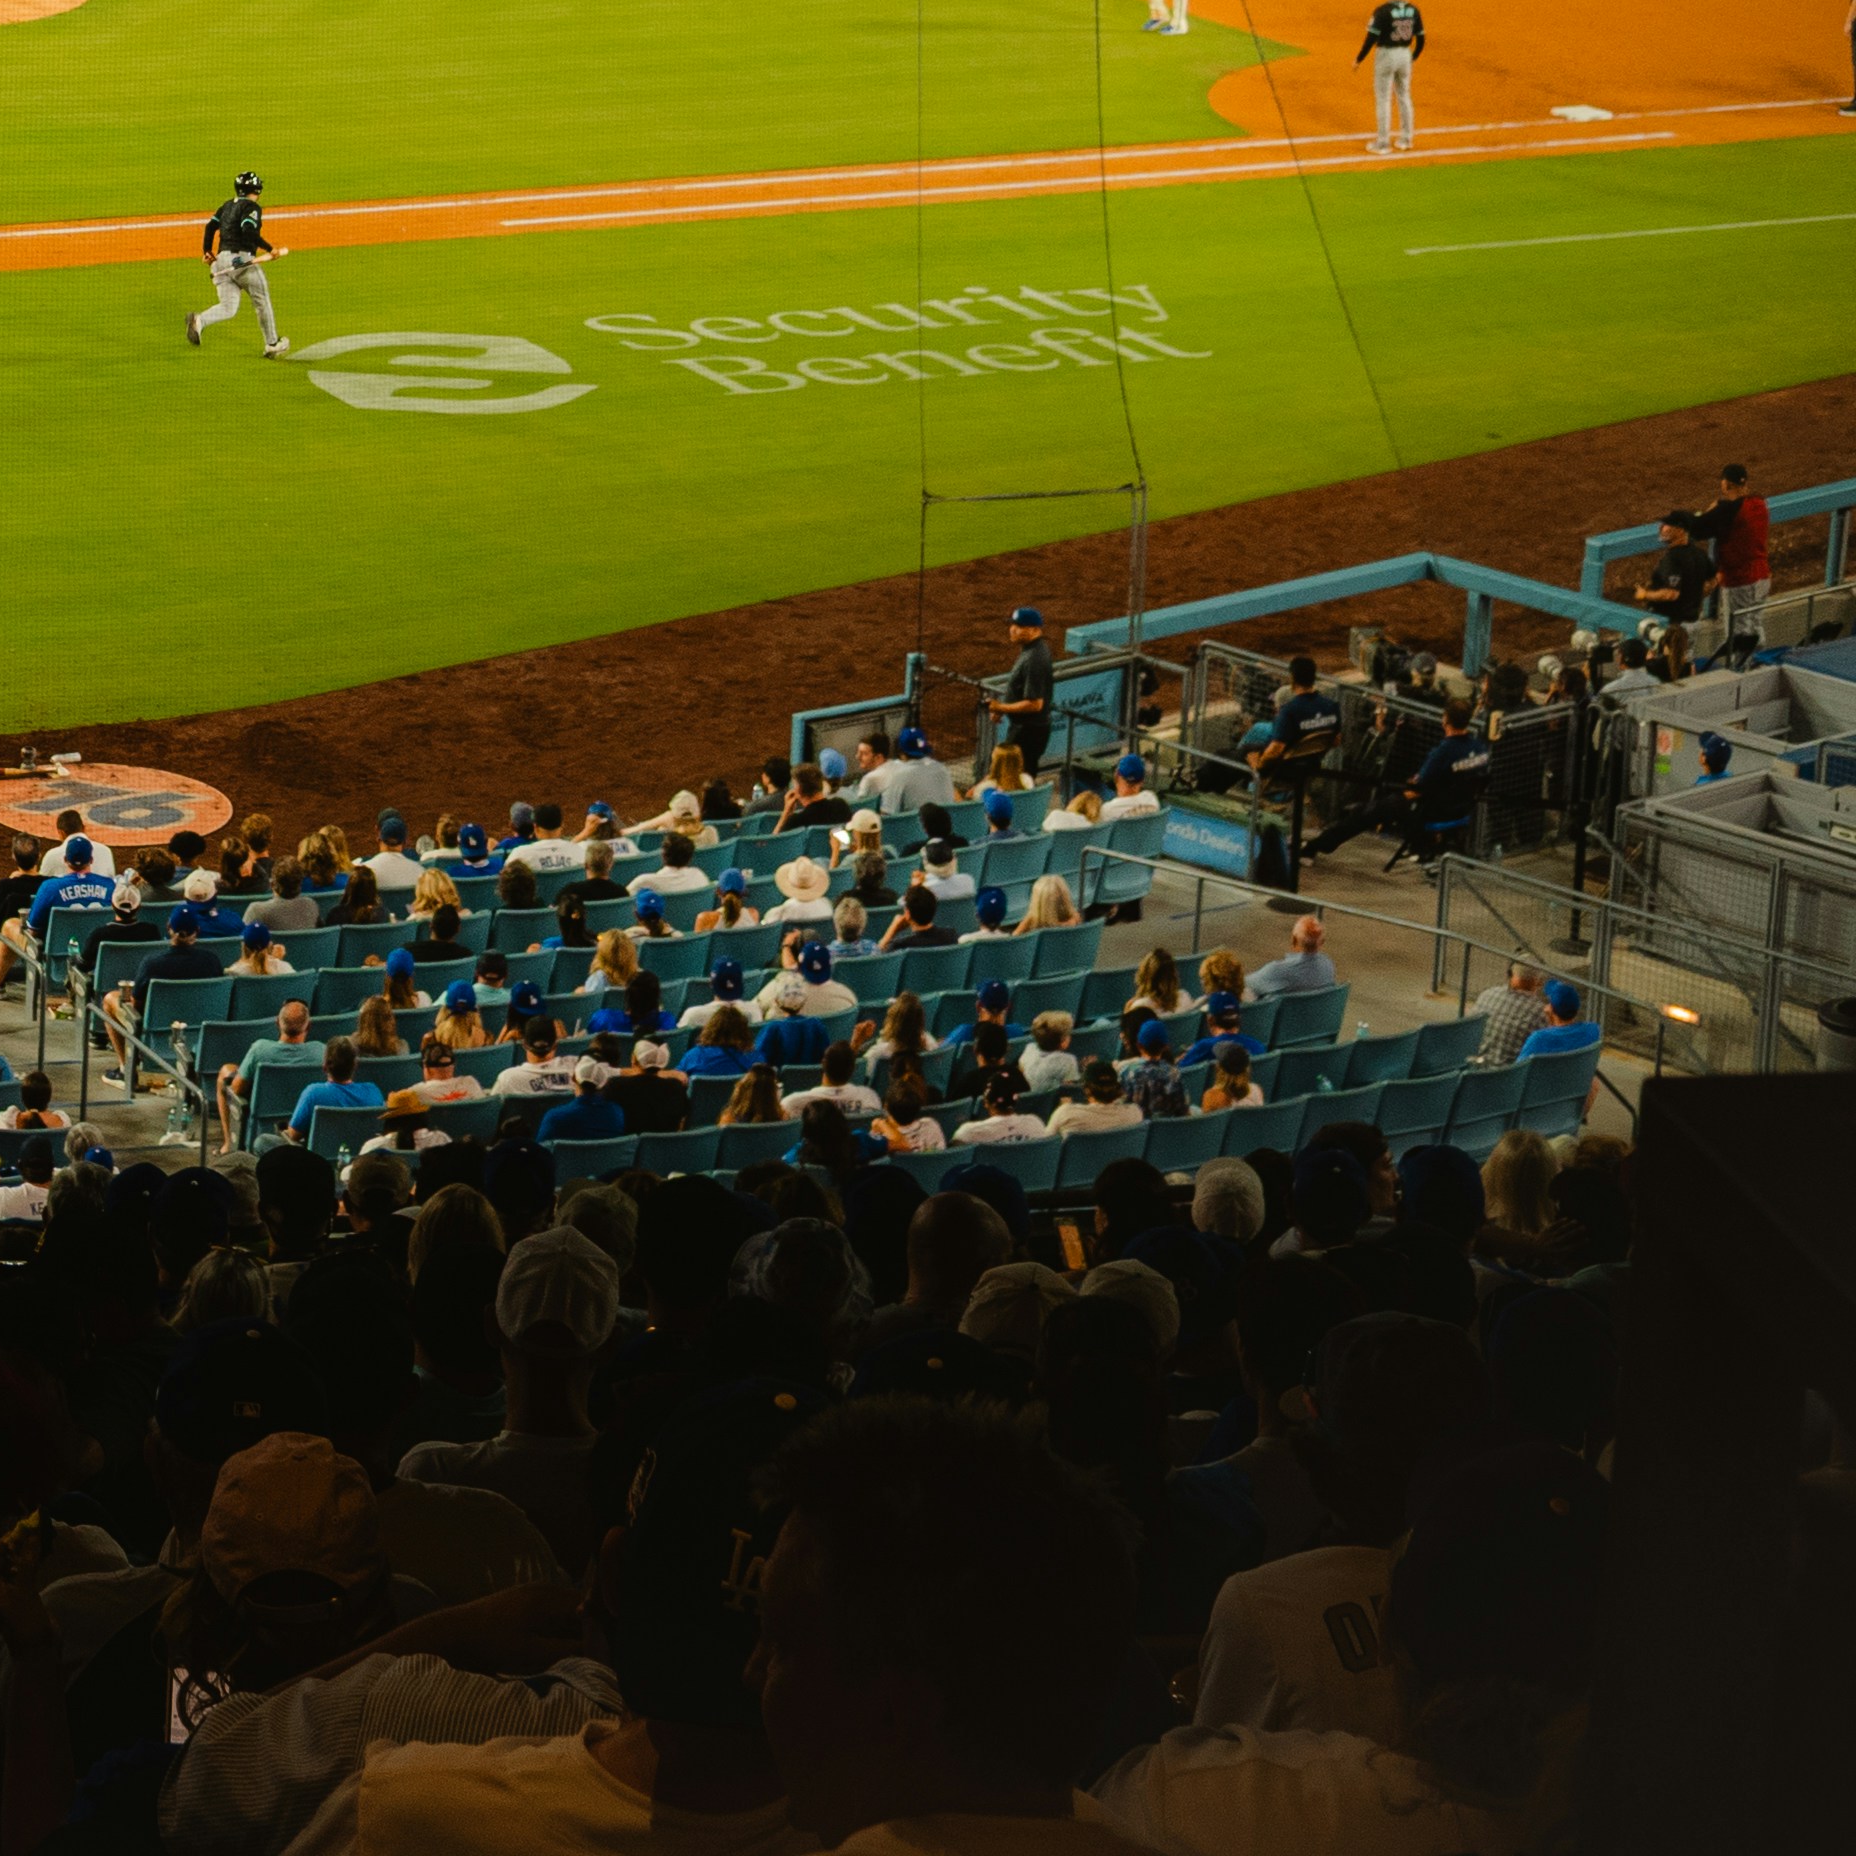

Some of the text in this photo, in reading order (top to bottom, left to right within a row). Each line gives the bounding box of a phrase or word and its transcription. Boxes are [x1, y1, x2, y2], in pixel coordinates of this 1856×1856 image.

[582, 284, 1171, 356] Security
[664, 327, 1215, 397] Benefit
[9, 779, 213, 830] 76
[59, 884, 107, 903] KERSHAW
